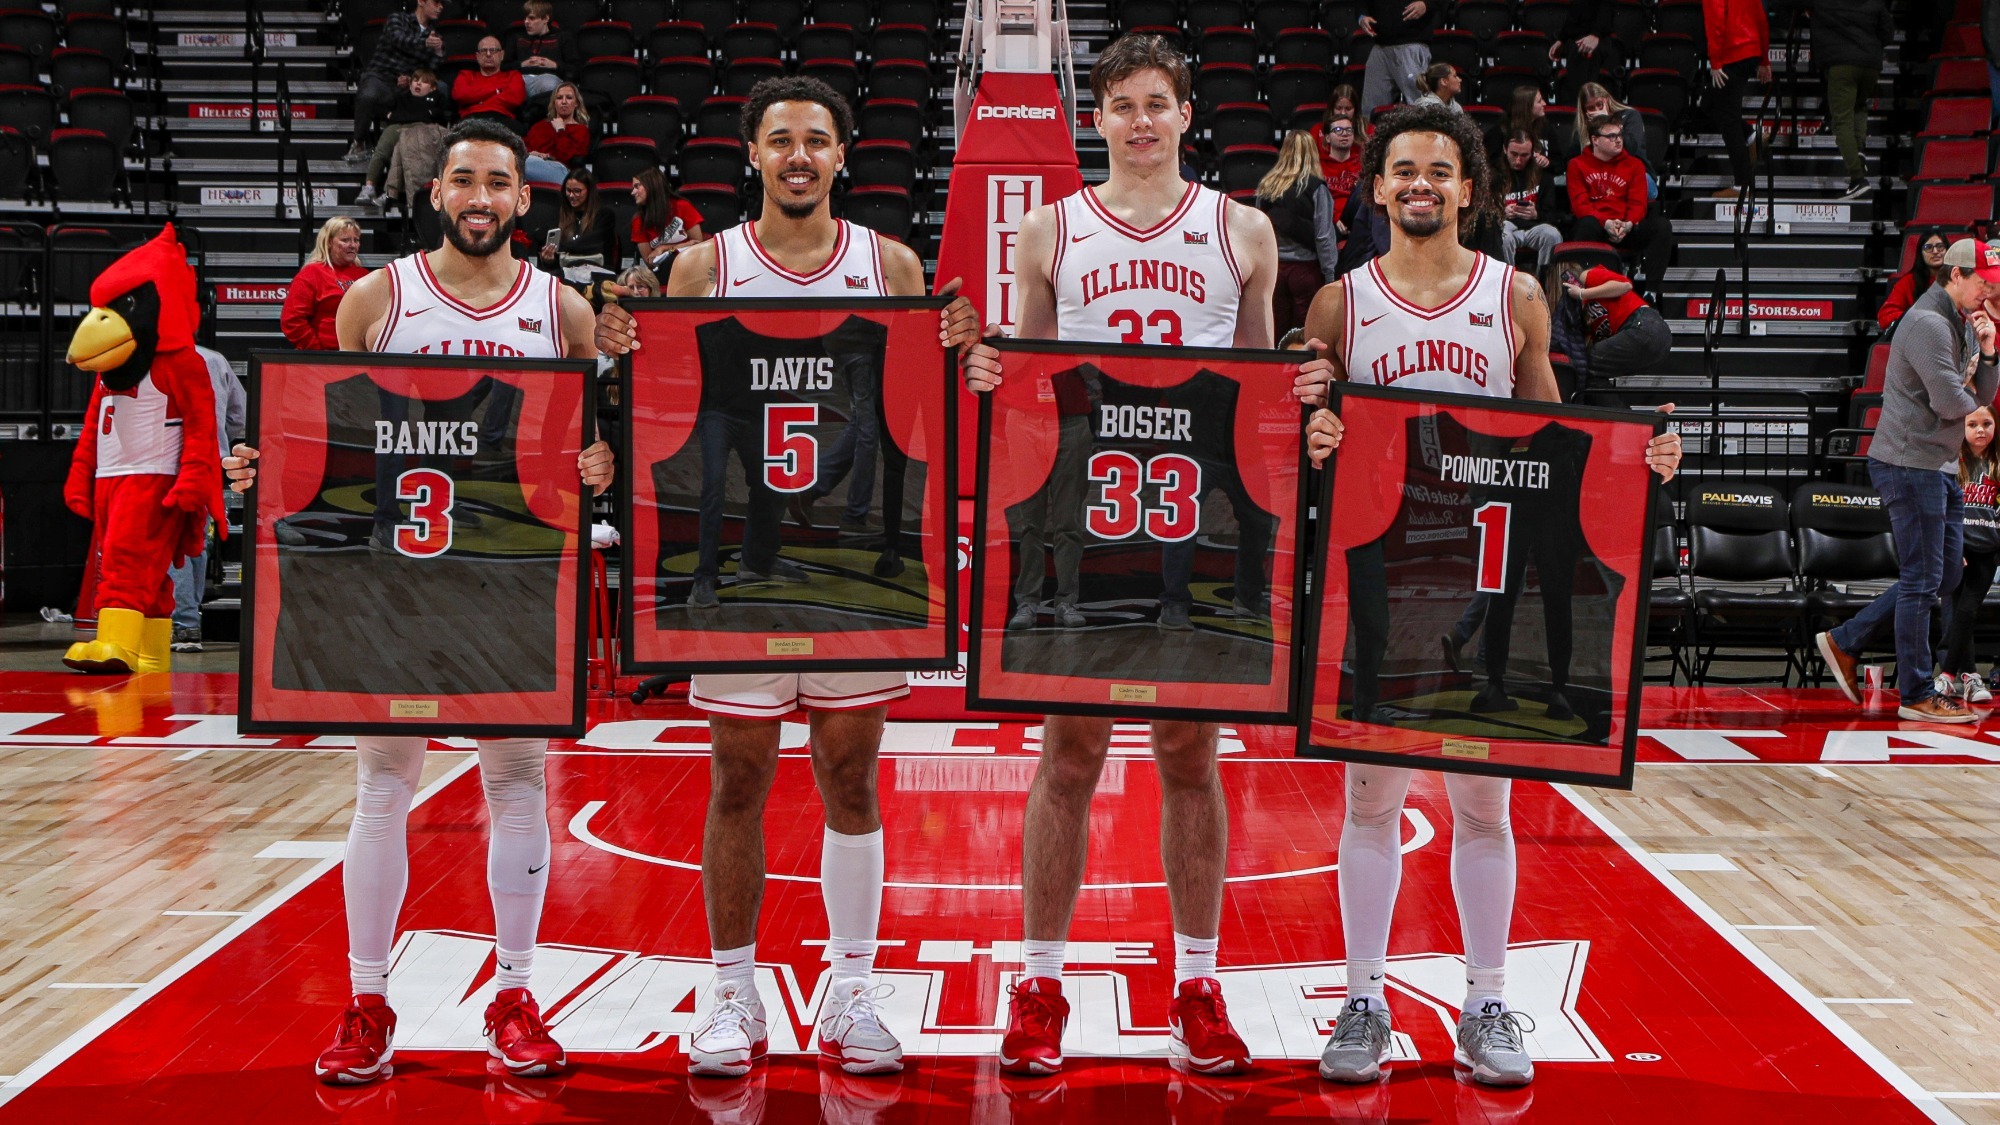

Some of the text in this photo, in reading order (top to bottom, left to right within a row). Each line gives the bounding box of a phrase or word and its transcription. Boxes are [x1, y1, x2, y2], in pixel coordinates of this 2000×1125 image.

[977, 105, 1056, 121] porter
[1081, 260, 1205, 307] ILLINOIS
[750, 357, 834, 391] DAVIS
[1371, 339, 1489, 388] ILLINOIS
[374, 420, 479, 456] BANKS
[1100, 404, 1193, 442] BOSER
[763, 403, 819, 493] 5
[1440, 454, 1550, 490] POINDEXTER
[393, 467, 455, 559] 3
[1086, 450, 1202, 543] 33
[1472, 500, 1512, 594] 1
